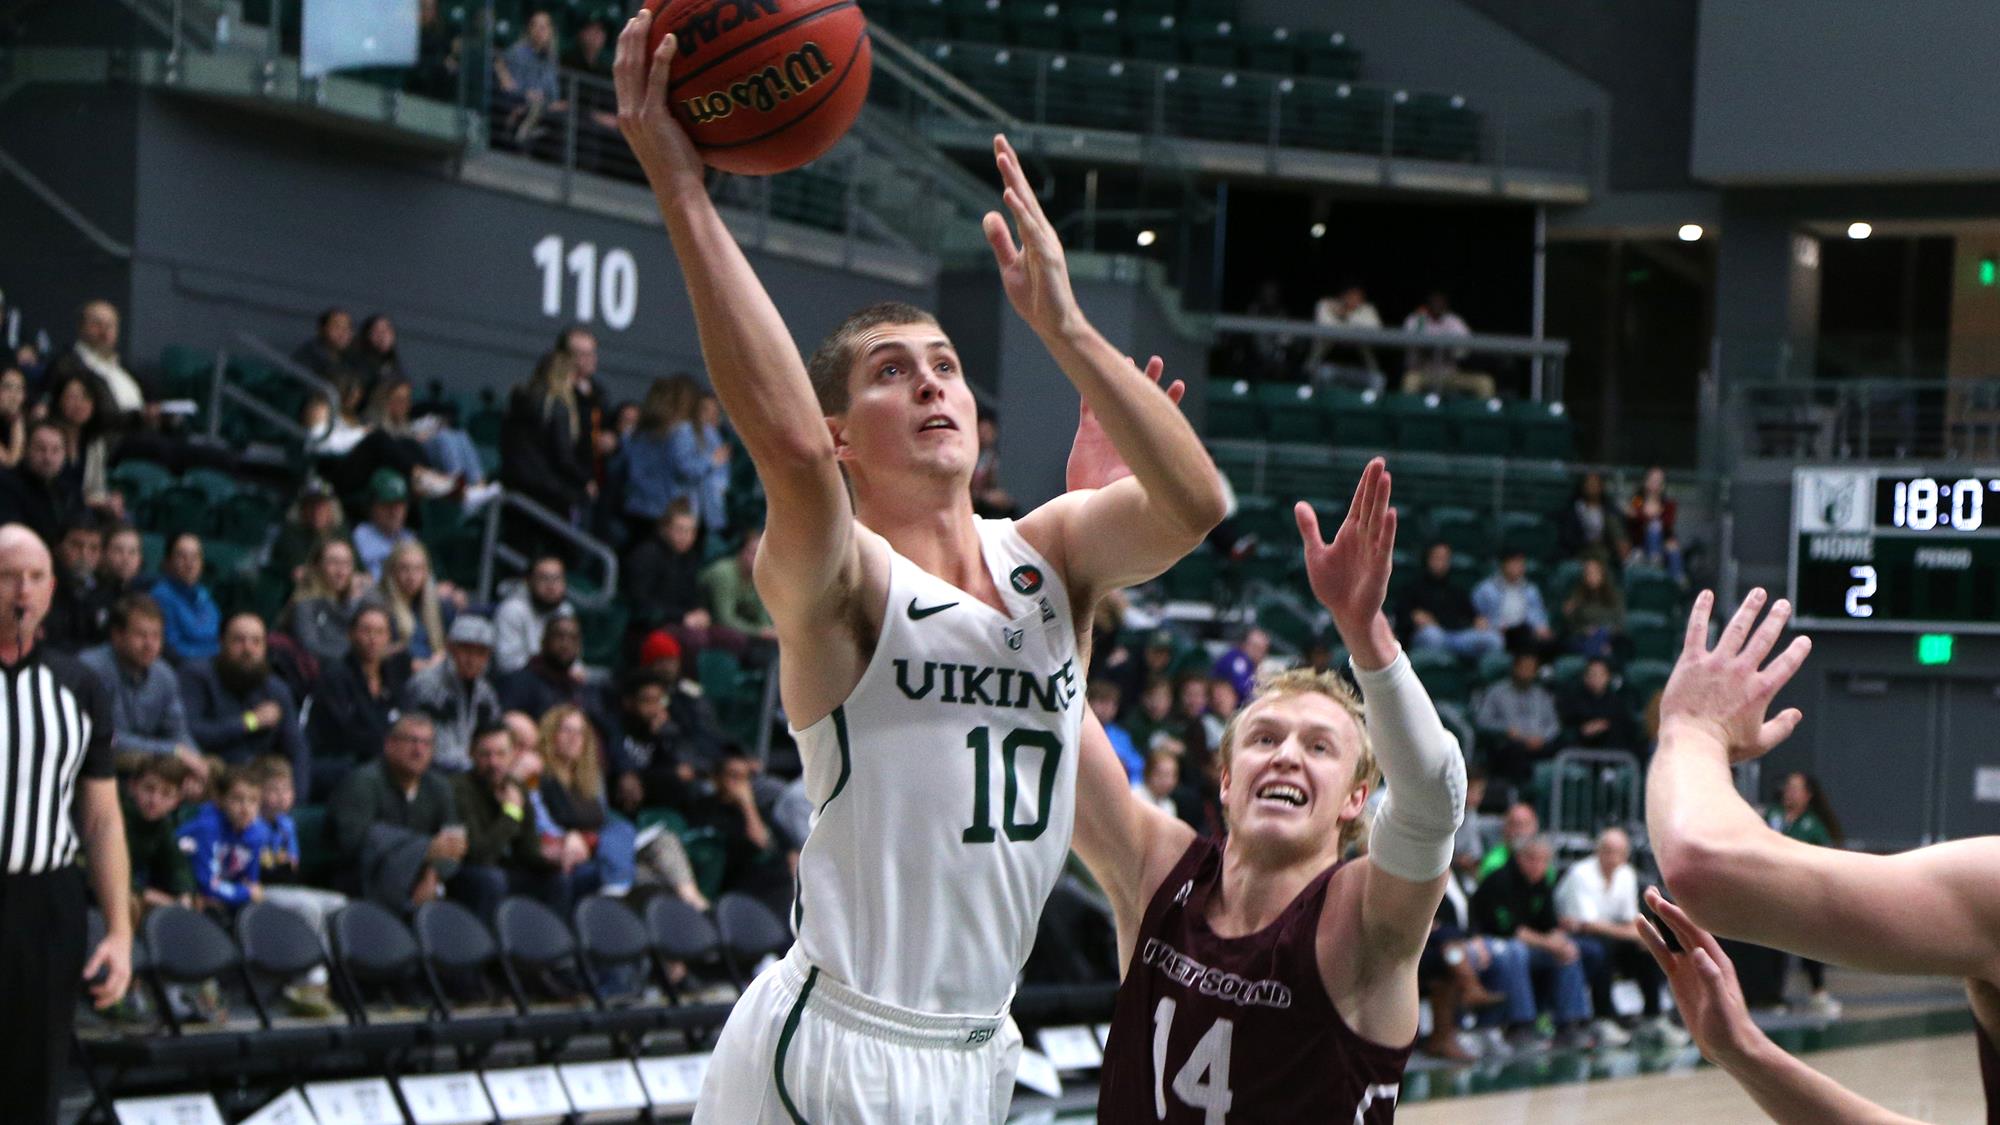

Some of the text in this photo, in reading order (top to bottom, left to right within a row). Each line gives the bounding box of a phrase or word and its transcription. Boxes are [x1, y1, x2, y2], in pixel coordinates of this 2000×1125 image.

[681, 41, 834, 124] Wilson
[533, 235, 639, 330] 110
[1894, 478, 2000, 531] 18:0
[1809, 536, 1875, 561] HOME
[1845, 565, 1877, 617] 2
[962, 726, 1063, 843] 10
[966, 1028, 996, 1043] PSU
[1153, 996, 1234, 1125] 14
